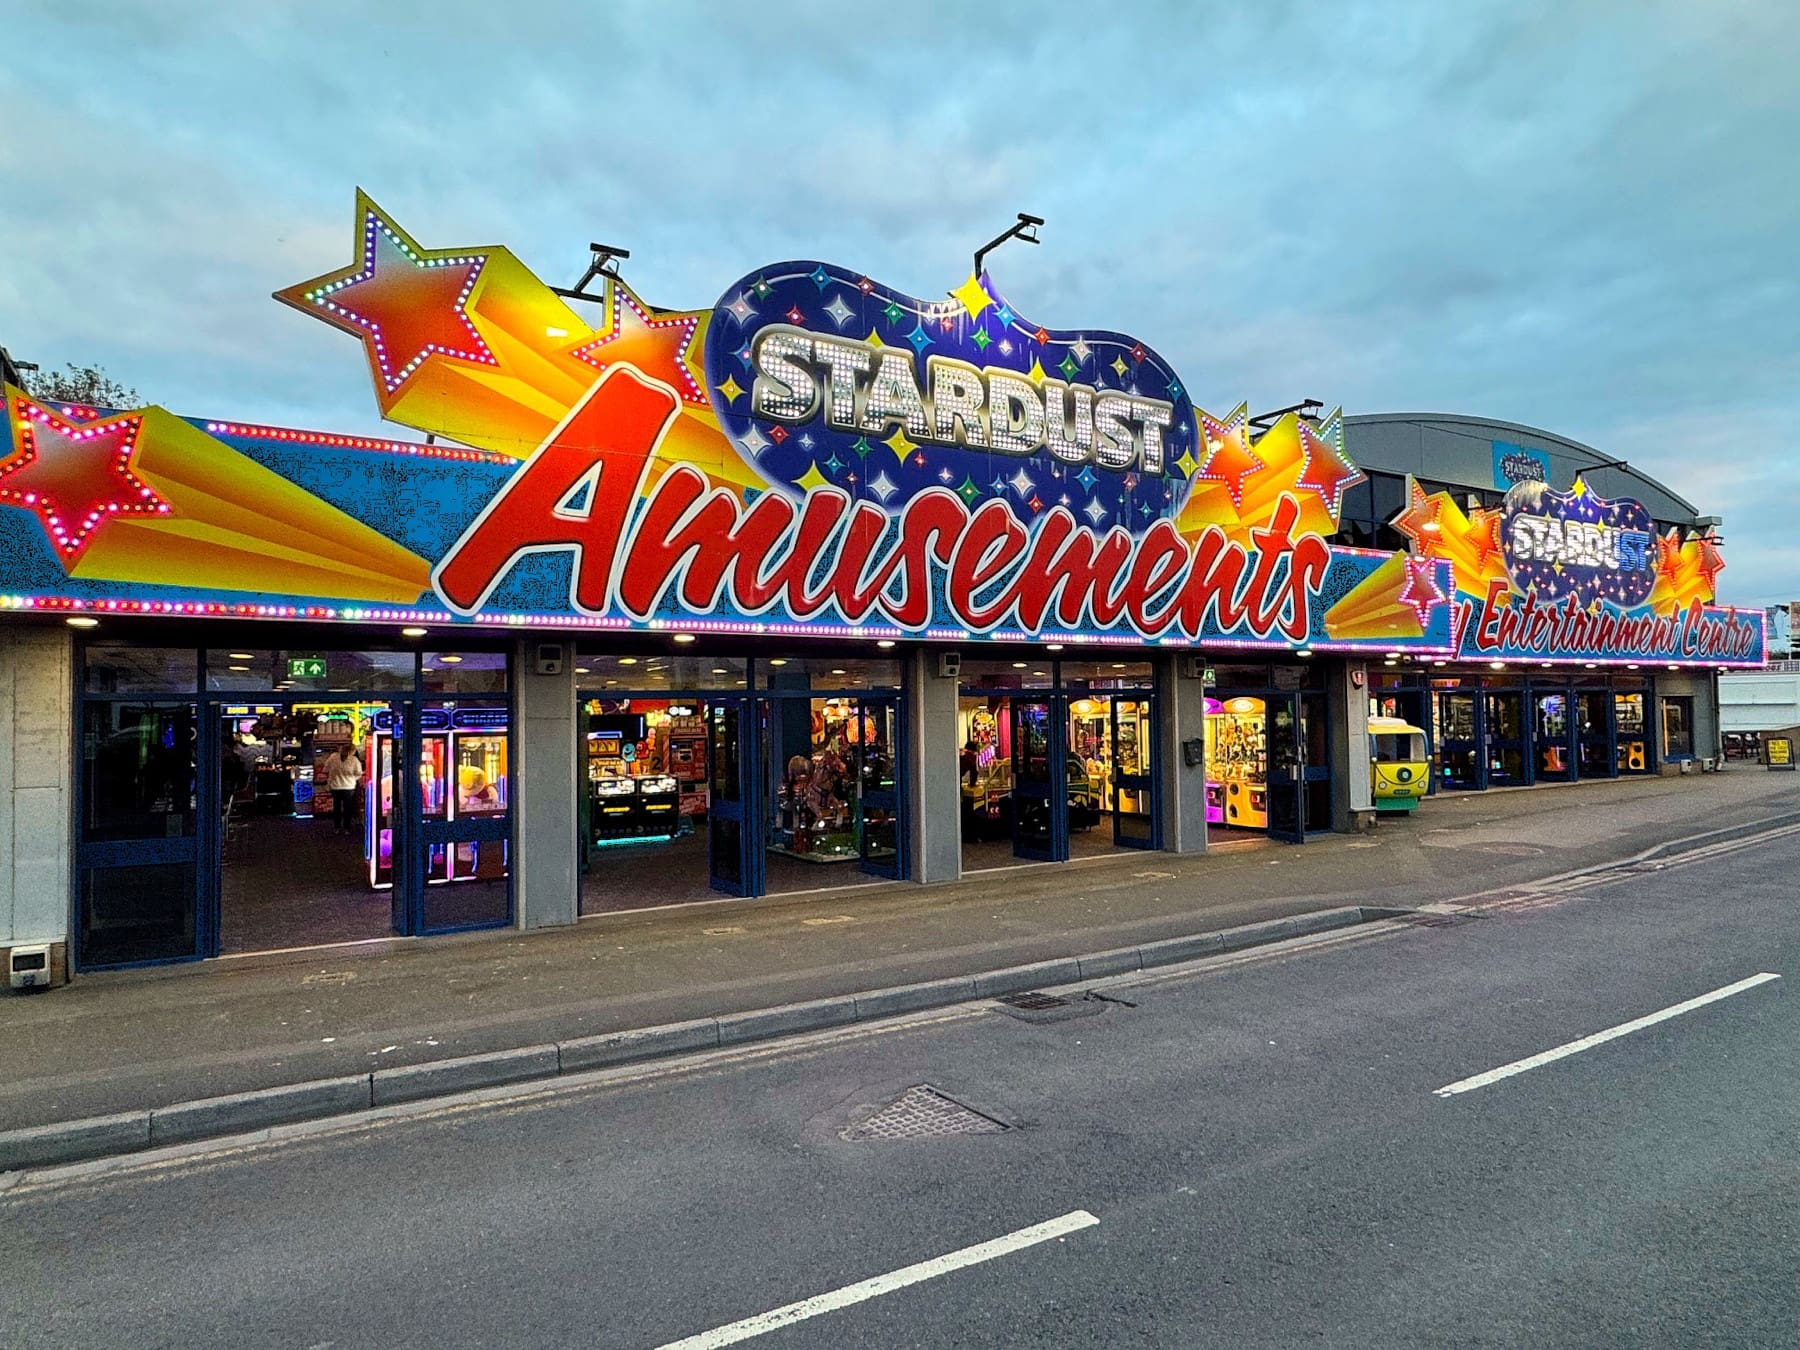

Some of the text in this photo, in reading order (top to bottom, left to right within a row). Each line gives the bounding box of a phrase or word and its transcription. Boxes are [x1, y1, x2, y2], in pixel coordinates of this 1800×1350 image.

[754, 325, 1175, 475] STARDUST
[432, 361, 1330, 645] Amusements
[1503, 460, 1541, 478] STARDUST
[1512, 516, 1650, 572] STARDUST
[1476, 577, 1681, 654] Entertainment
[1680, 596, 1757, 659] Centre
